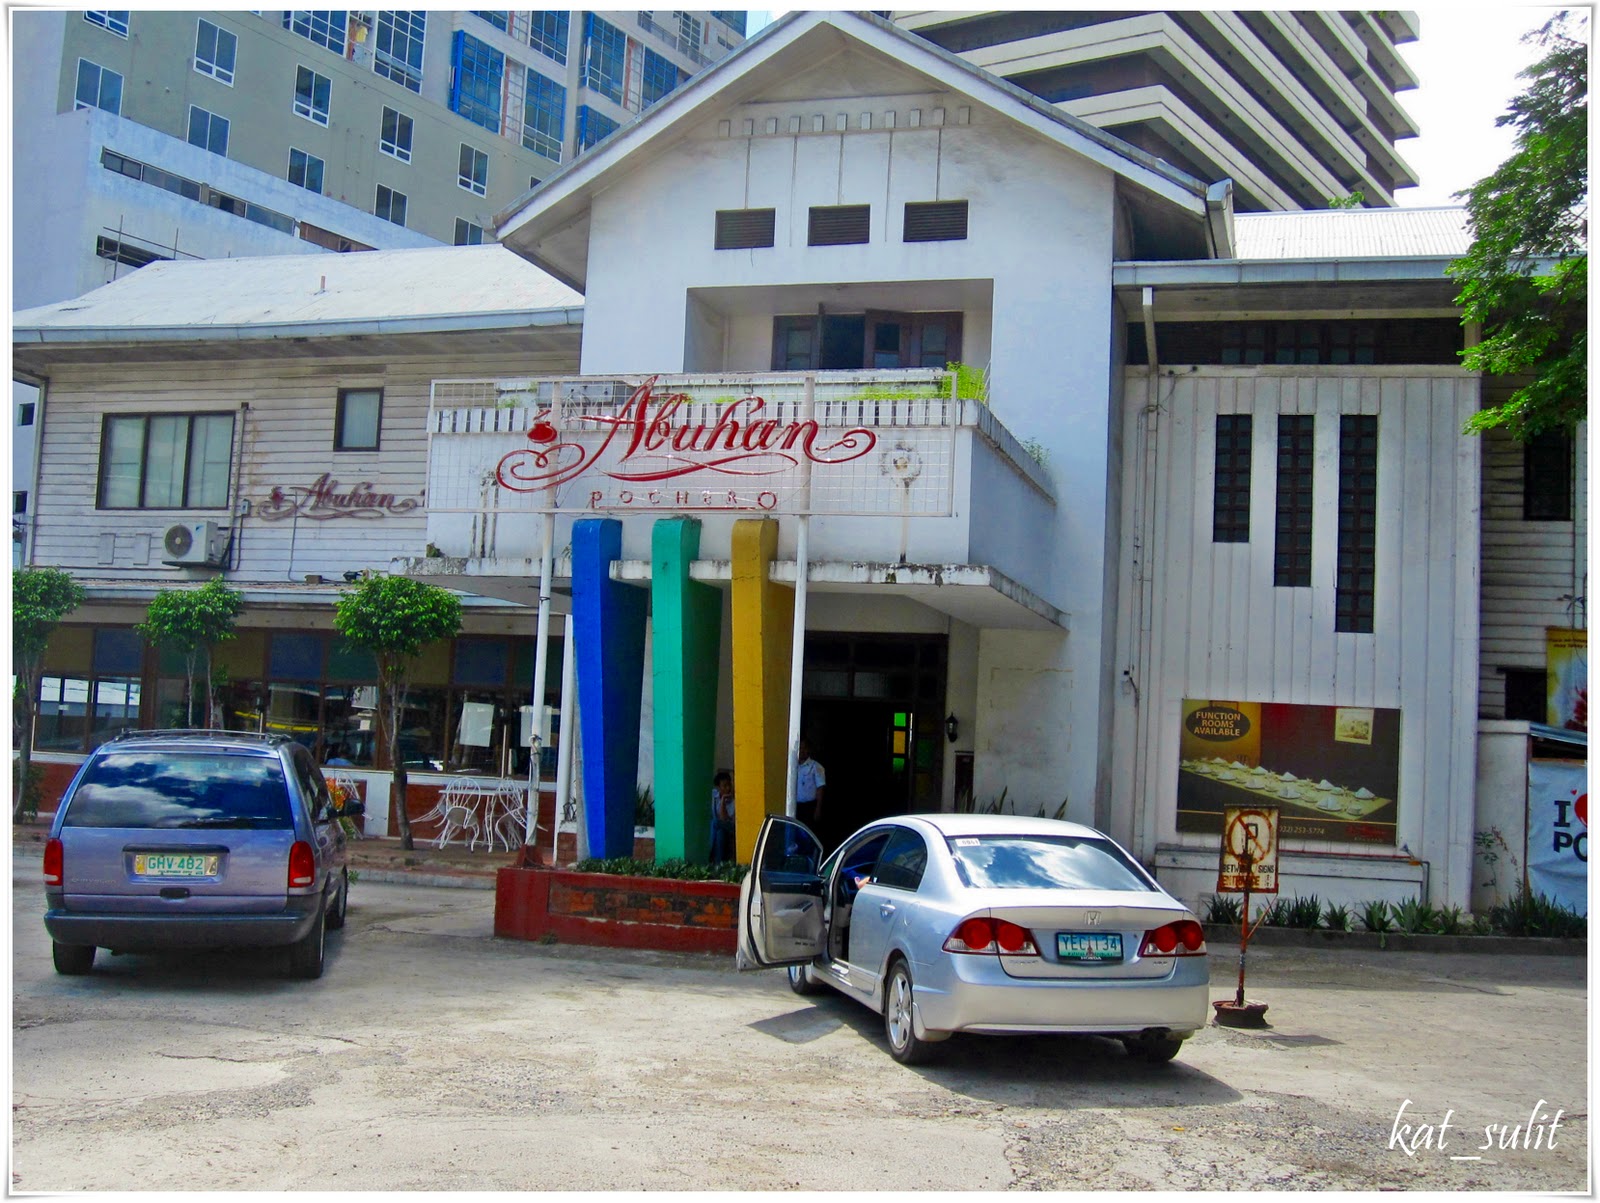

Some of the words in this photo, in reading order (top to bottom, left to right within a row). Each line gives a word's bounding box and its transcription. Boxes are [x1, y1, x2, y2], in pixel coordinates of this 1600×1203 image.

[496, 375, 877, 493] Abuhan
[257, 473, 417, 522] Abuhan
[1195, 711, 1241, 721] FUNCTION
[1201, 719, 1235, 729] ROOMS
[1193, 726, 1241, 737] AVAILABLE
[1554, 801, 1571, 828] I
[1258, 864, 1275, 874] SIGNS
[1062, 935, 1086, 951] YEC
[1095, 936, 1118, 951] 134
